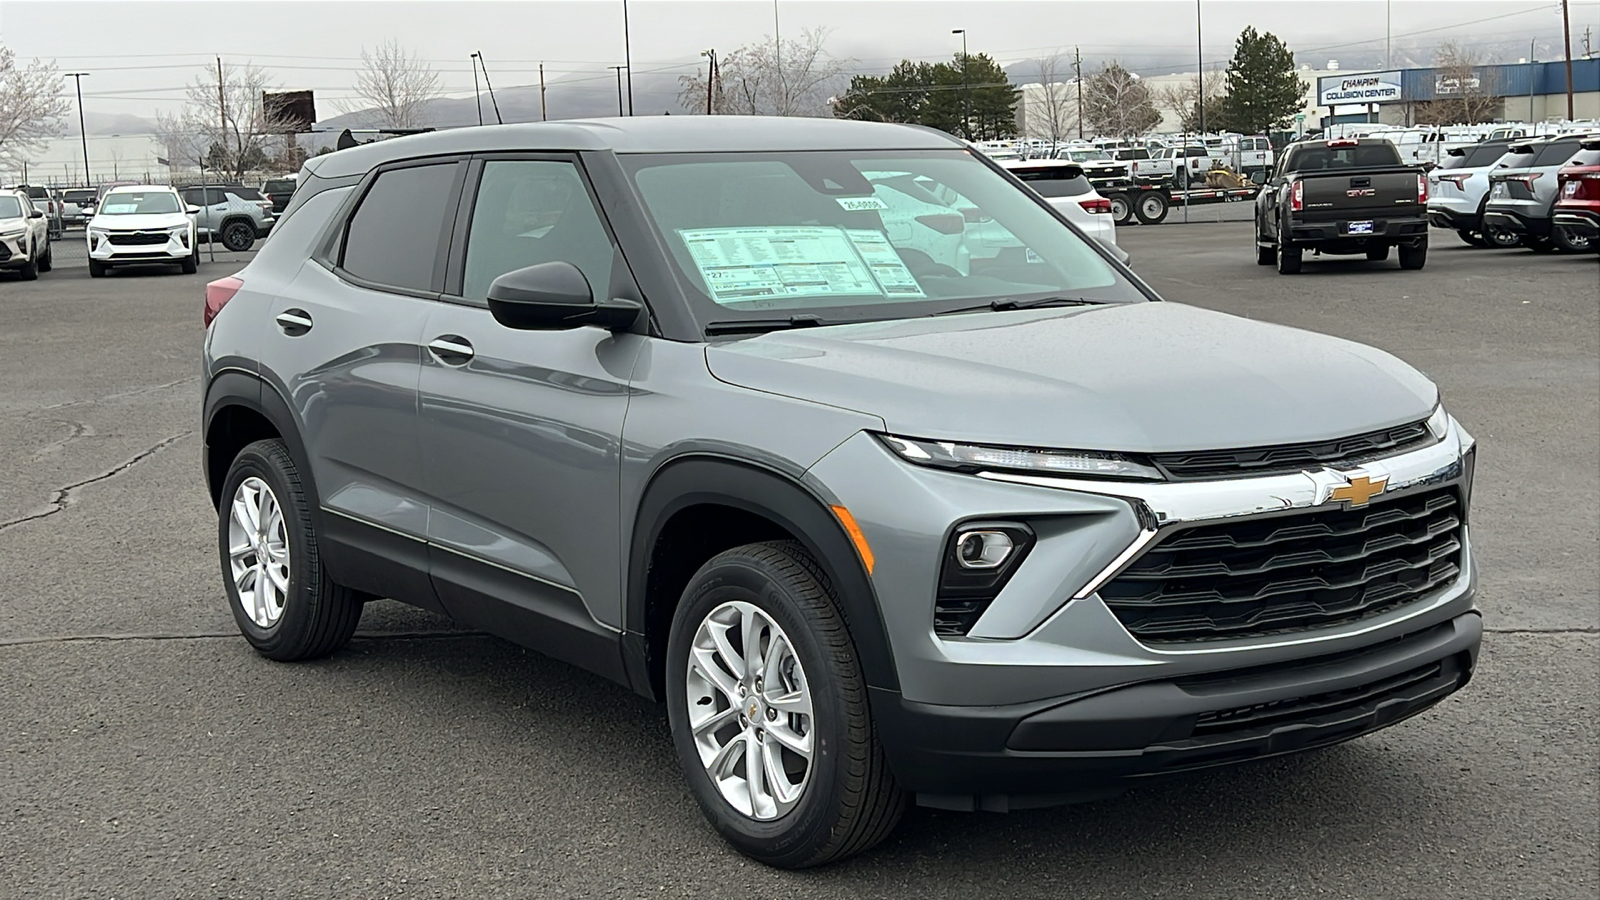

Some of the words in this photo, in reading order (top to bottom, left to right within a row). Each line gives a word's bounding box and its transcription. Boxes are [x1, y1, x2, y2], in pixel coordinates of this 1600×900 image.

[1326, 91, 1365, 100] COLLISION
[1365, 88, 1396, 98] CENTER
[1346, 188, 1375, 197] GMC
